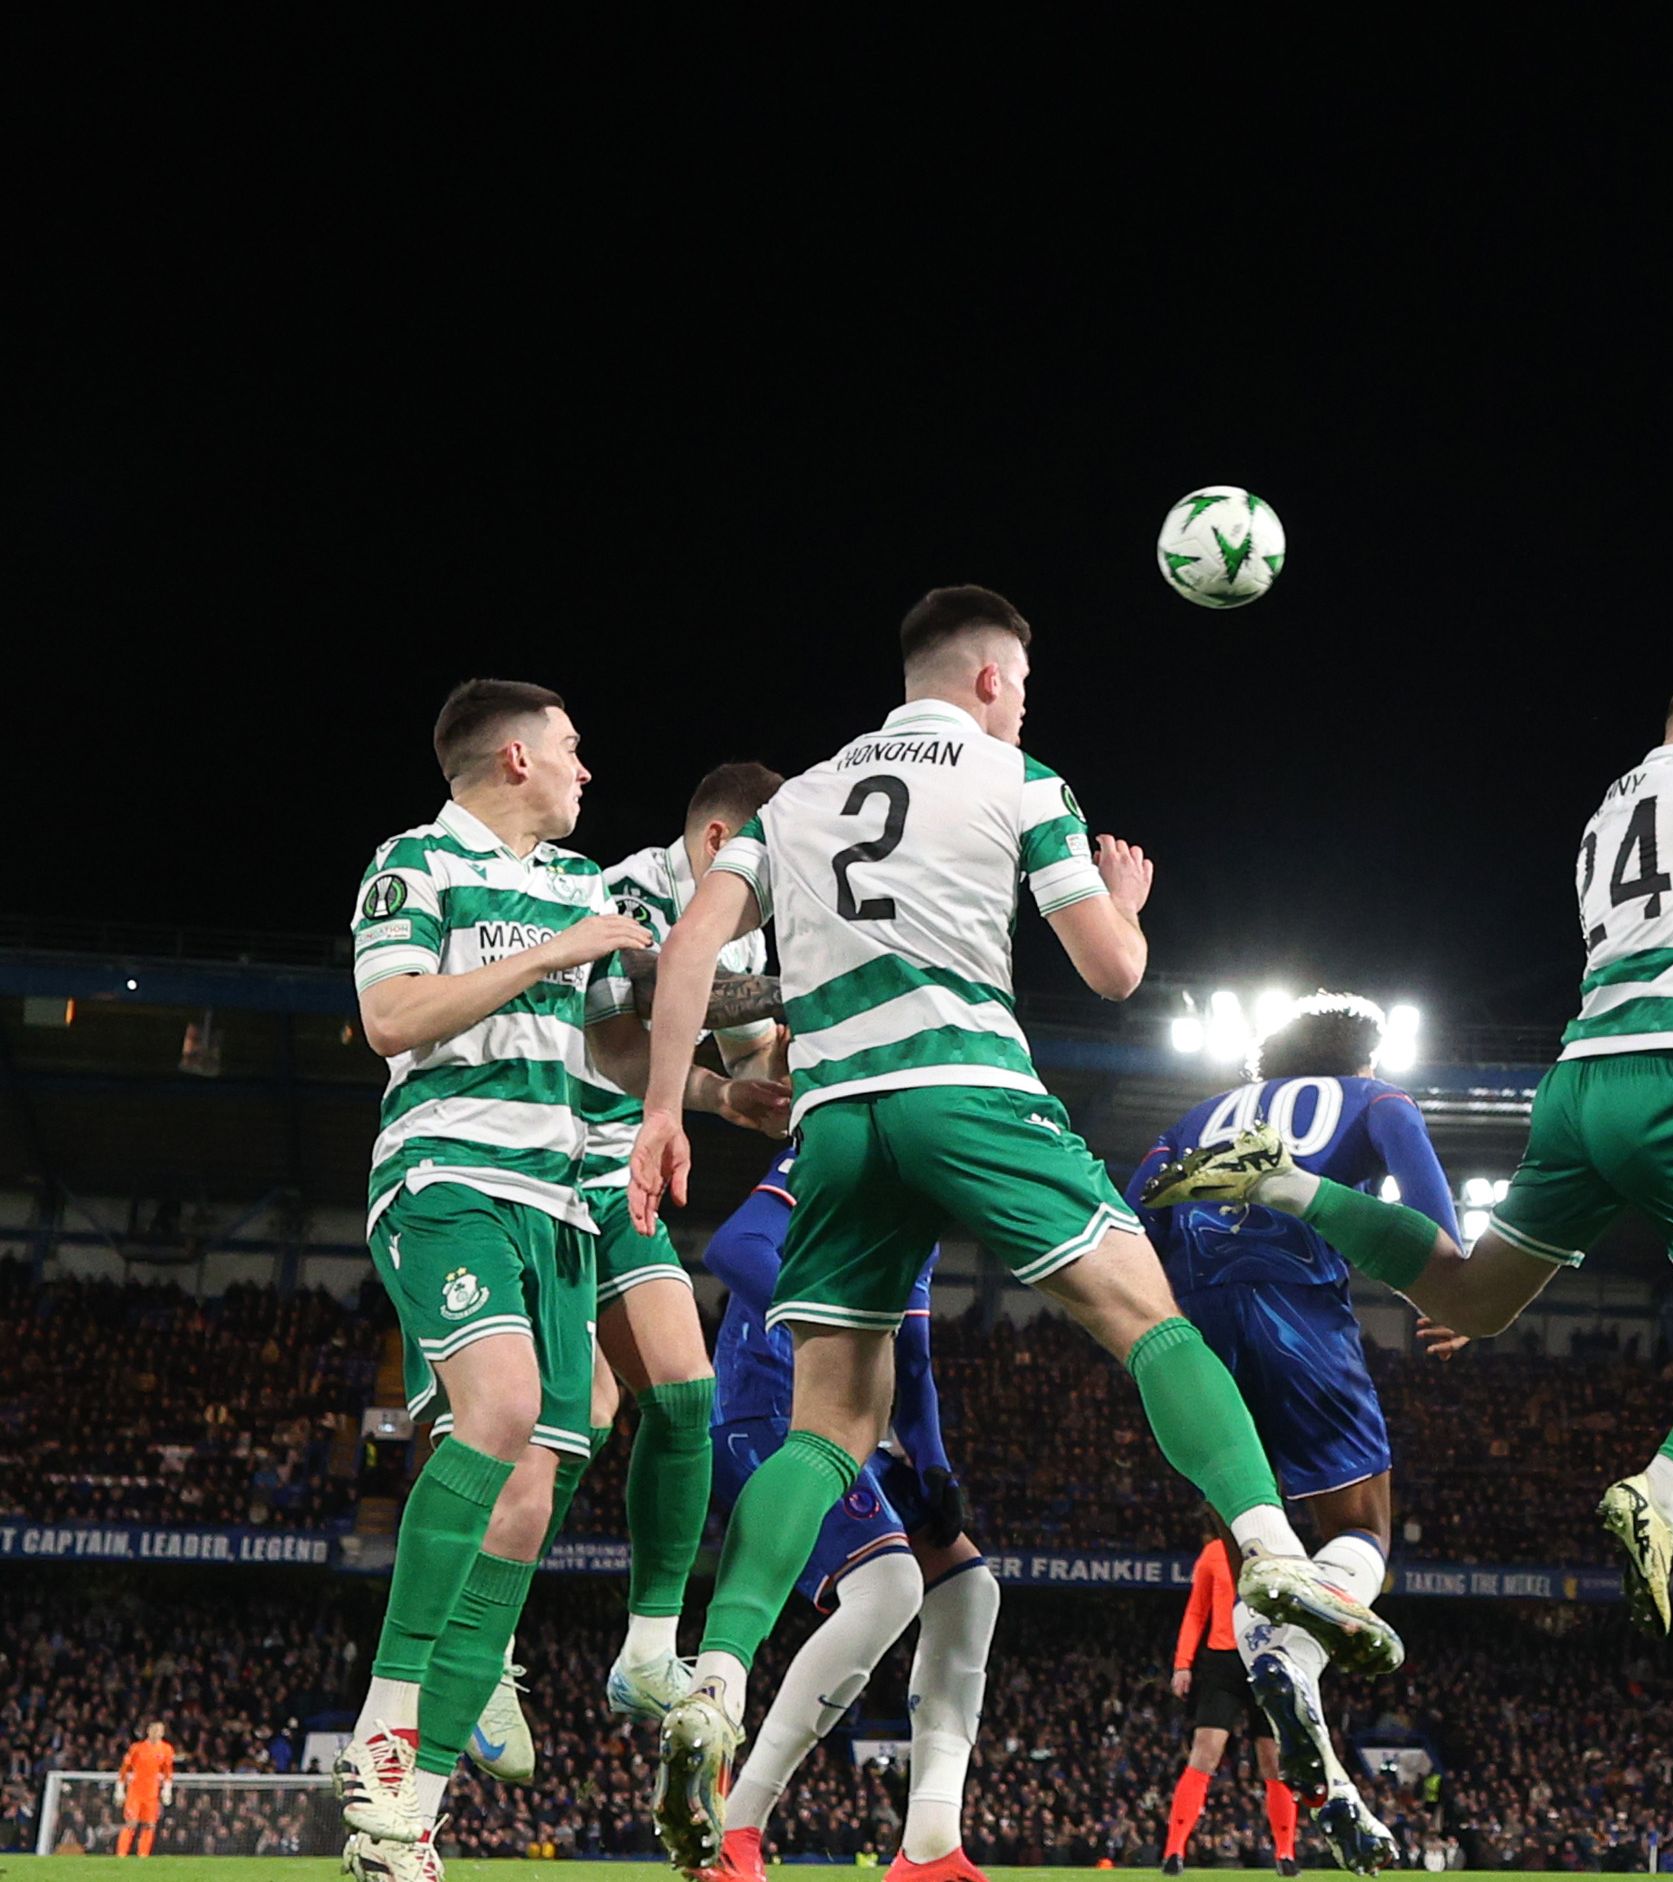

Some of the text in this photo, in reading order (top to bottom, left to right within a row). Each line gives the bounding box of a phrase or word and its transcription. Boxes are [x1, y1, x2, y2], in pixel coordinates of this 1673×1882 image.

[832, 774, 910, 921] 2
[1579, 795, 1672, 950] 24
[1199, 1076, 1344, 1157] 40
[22, 1528, 134, 1558] CAPTAIN,
[140, 1531, 235, 1561] LEADER,
[240, 1535, 328, 1564] LEGEND
[1031, 1557, 1163, 1582] FRANKIE
[1405, 1571, 1465, 1595] TAKING
[1470, 1571, 1499, 1596] THE
